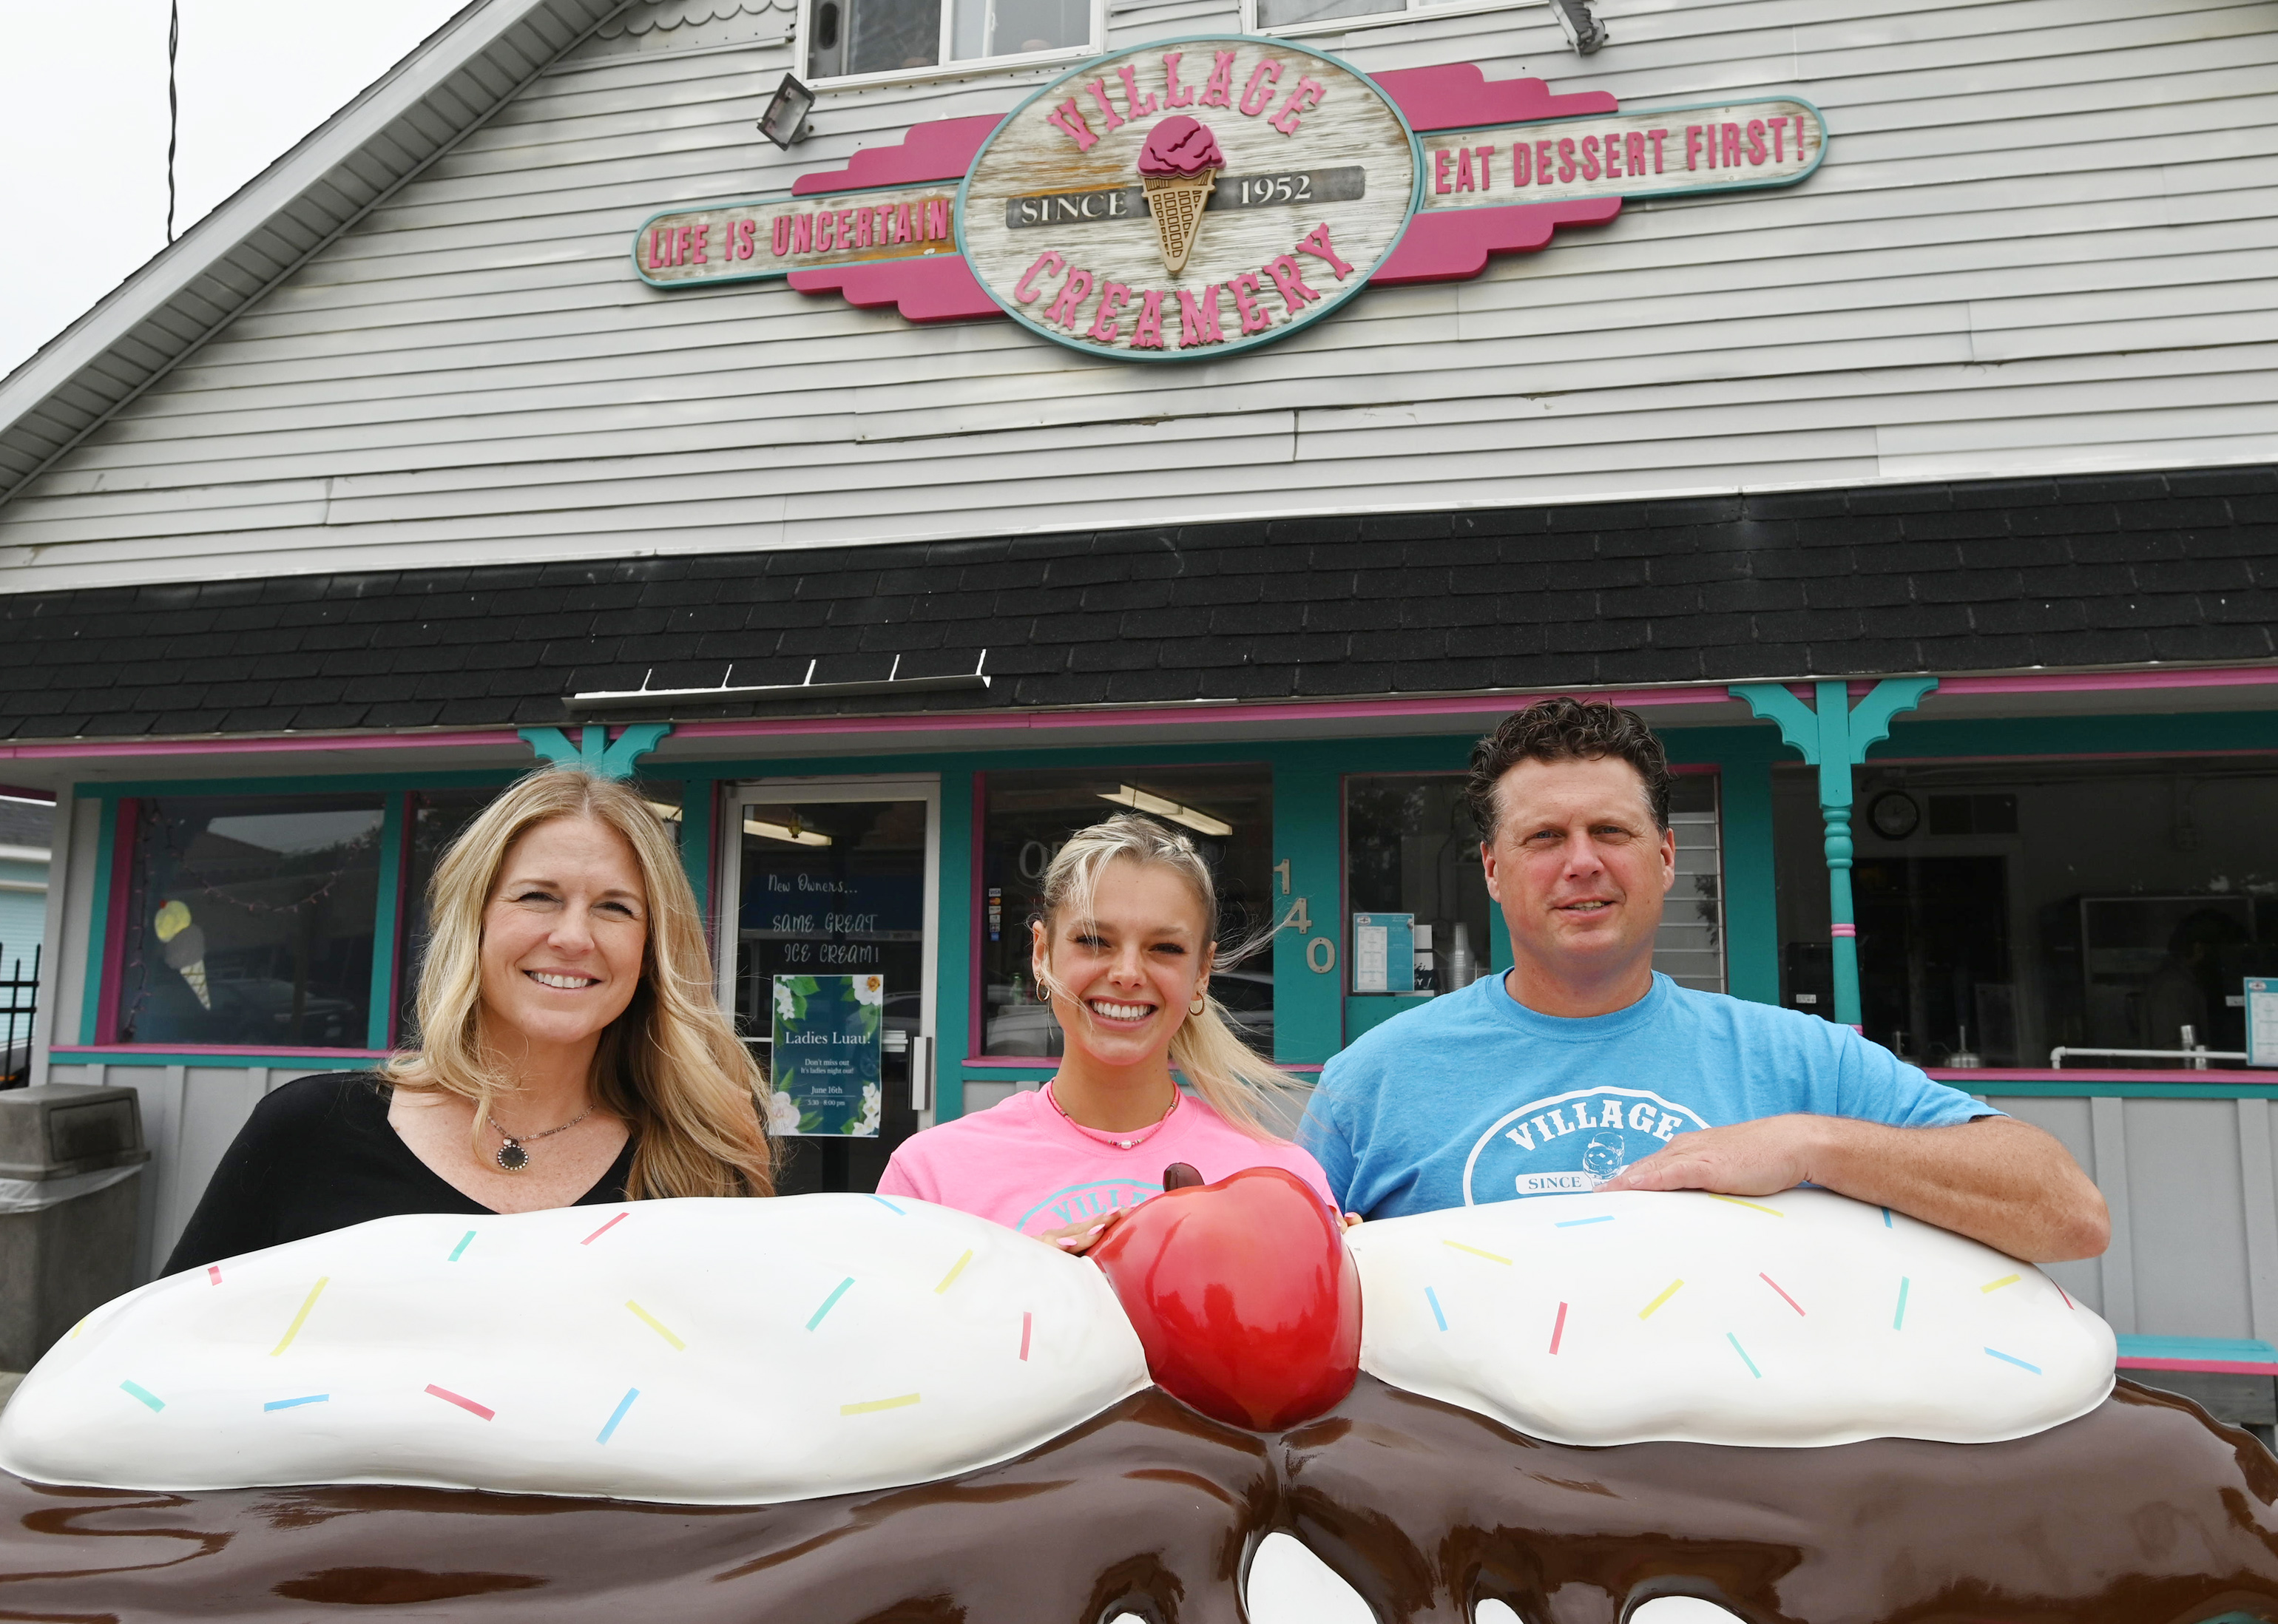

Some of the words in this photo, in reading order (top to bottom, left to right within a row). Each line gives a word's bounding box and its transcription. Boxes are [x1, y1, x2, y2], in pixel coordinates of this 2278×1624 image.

[1047, 50, 1326, 151] VILLAGE
[1436, 146, 1495, 194] EAT
[1513, 129, 1668, 187] DESSERT
[1686, 115, 1804, 171] FIRST!
[1021, 191, 1128, 223] SINCE
[1240, 175, 1313, 204] 1952
[648, 224, 709, 269] LIFE
[724, 219, 756, 261] IS
[771, 198, 949, 257] UNCERTAIN
[1014, 222, 1354, 348] CREAMERY
[768, 873, 791, 892] New
[797, 873, 858, 894] Owners...
[772, 914, 815, 933] SAME
[825, 912, 879, 933] GREAT
[784, 943, 811, 963] ICE
[819, 944, 879, 964] CREAM!
[785, 1031, 828, 1045] Ladies
[833, 1031, 871, 1045] Luau!
[805, 1058, 822, 1066] Don't
[823, 1058, 838, 1066] miss
[827, 1067, 842, 1075] night
[811, 1086, 827, 1094] June
[1505, 1099, 1683, 1151] VILLAGE
[1528, 1176, 1582, 1190] SINCE
